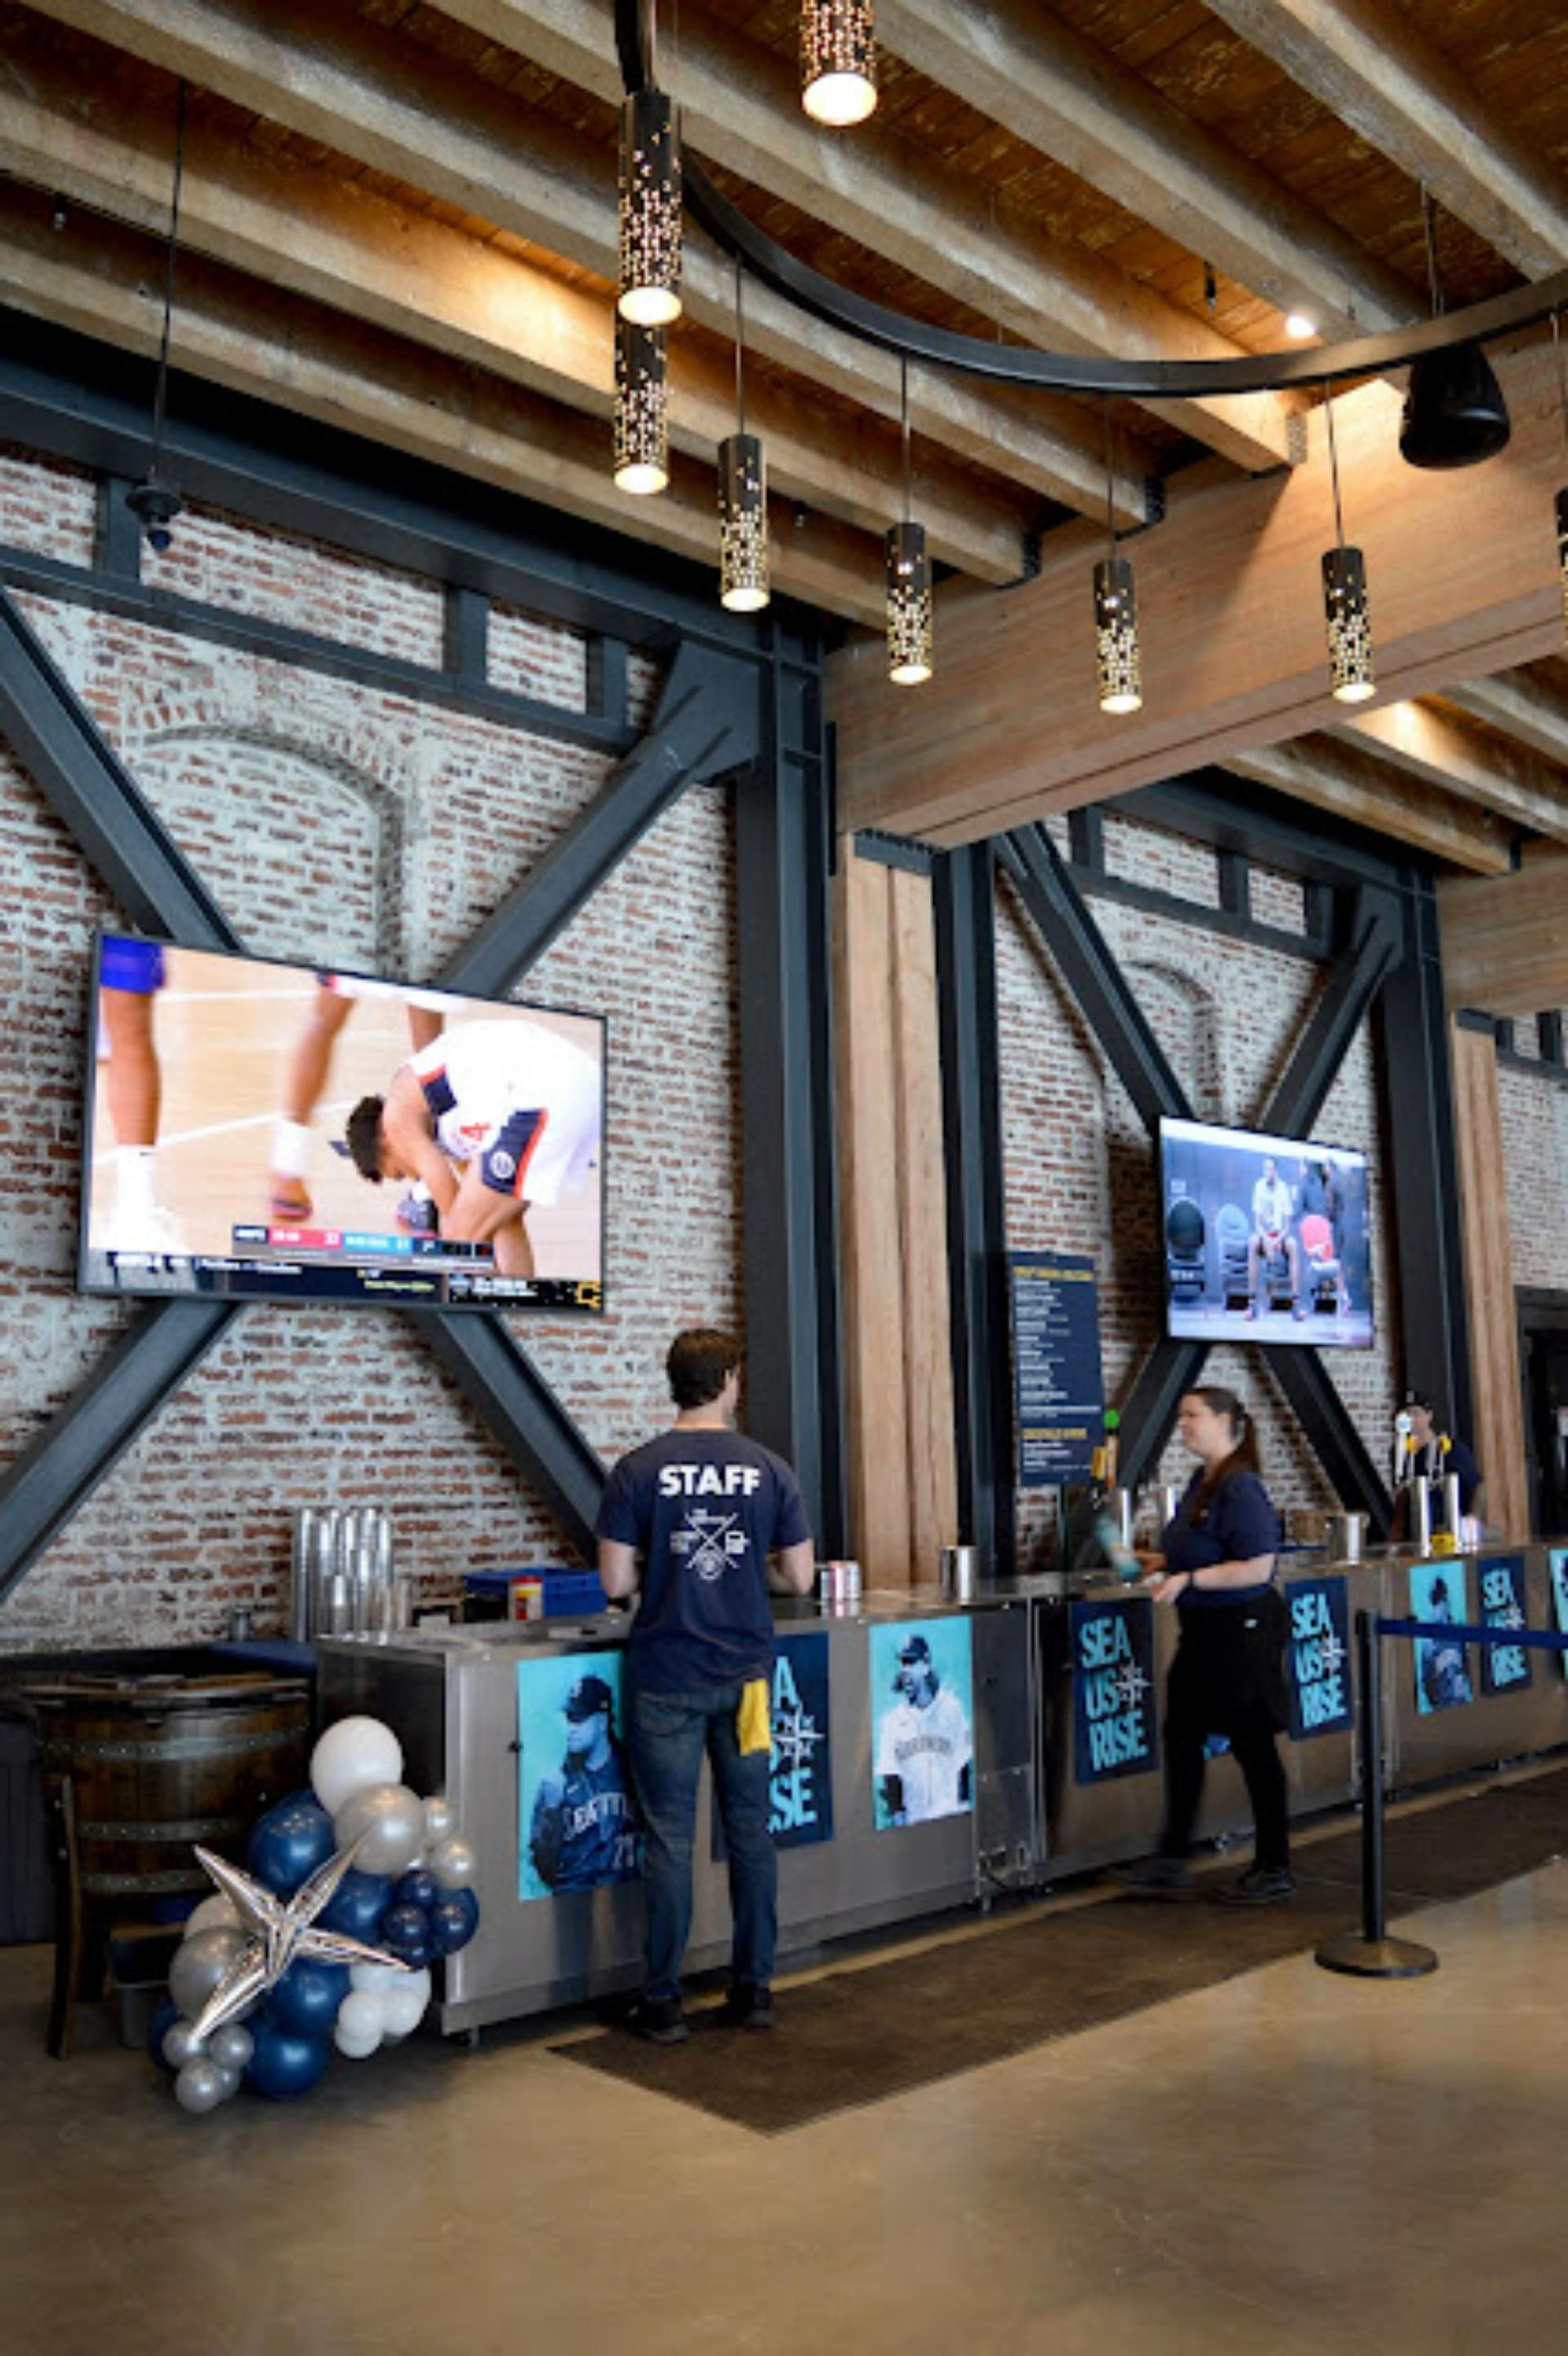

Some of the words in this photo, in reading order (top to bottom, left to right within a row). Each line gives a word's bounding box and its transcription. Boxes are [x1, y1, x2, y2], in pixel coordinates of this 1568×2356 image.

[658, 1465, 760, 1496] STAFF
[1080, 1616, 1131, 1668] SEA
[1291, 1593, 1331, 1640] SEA
[1295, 1637, 1324, 1684] US
[1085, 1668, 1120, 1720] US
[1300, 1675, 1346, 1729] RISE
[1089, 1709, 1148, 1771] RISE
[768, 1767, 817, 1833] SE
